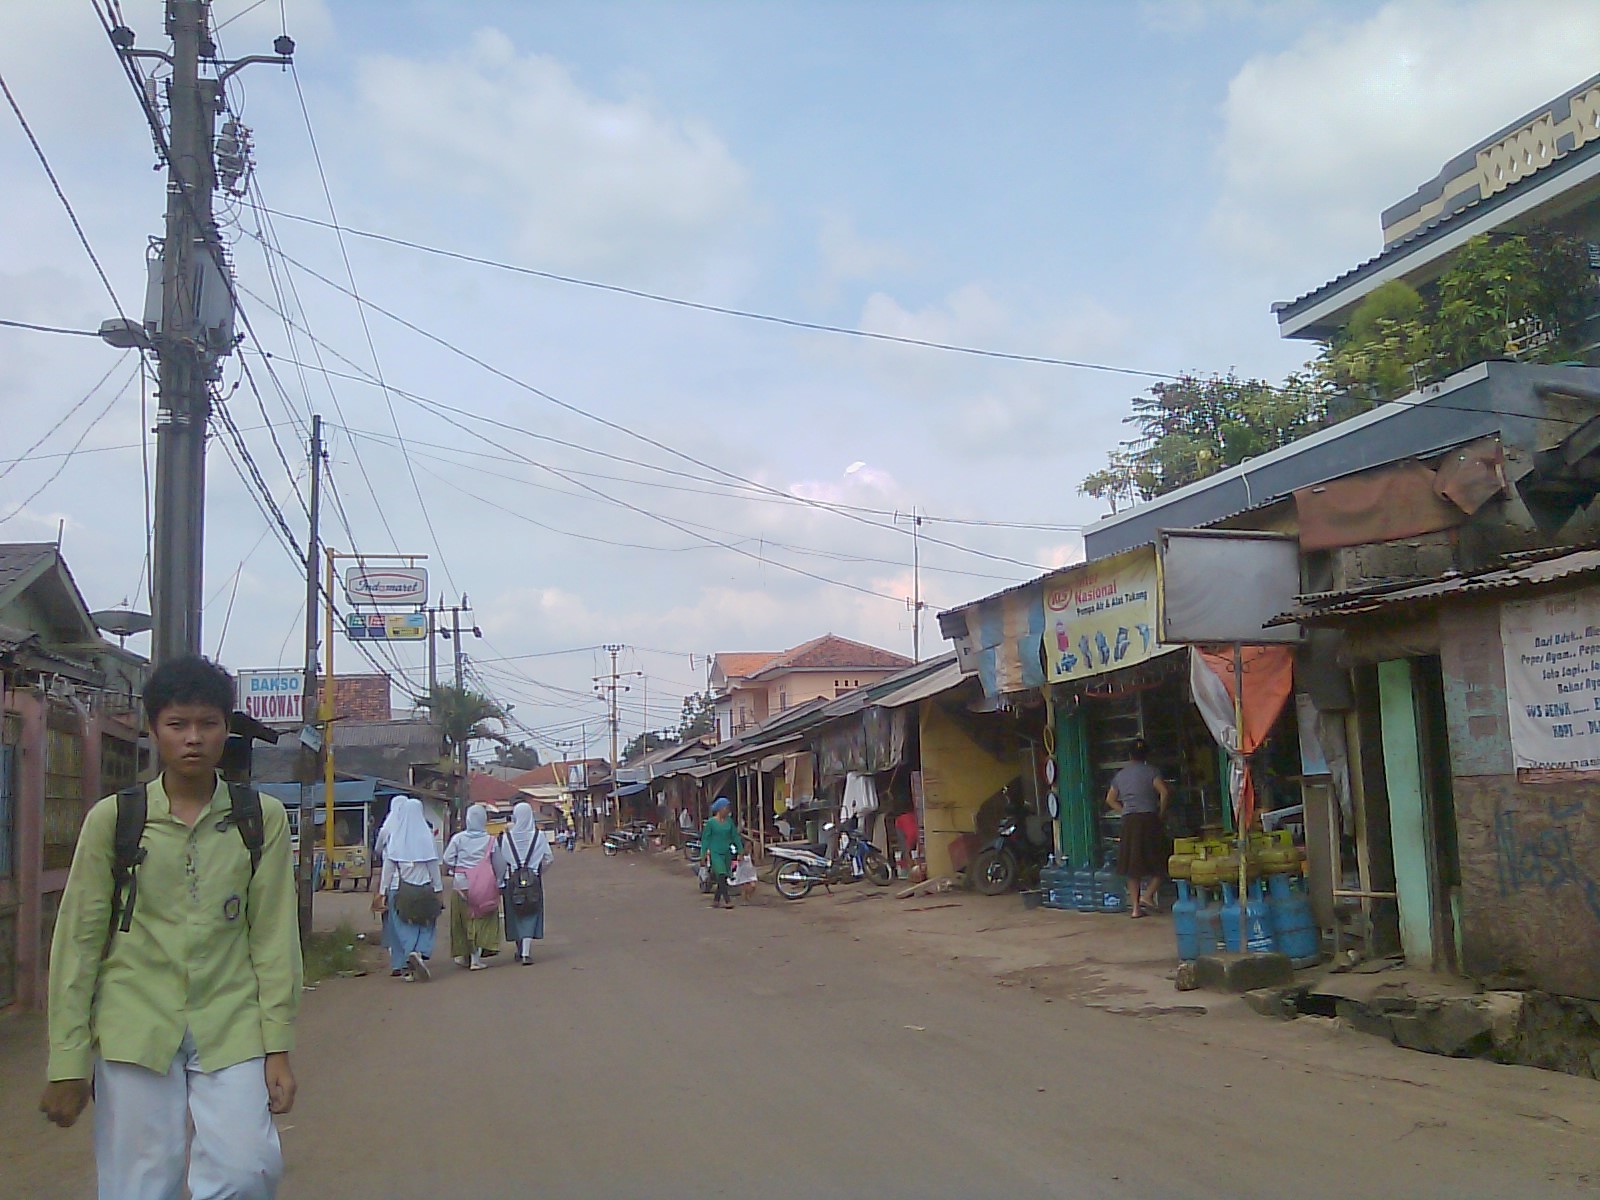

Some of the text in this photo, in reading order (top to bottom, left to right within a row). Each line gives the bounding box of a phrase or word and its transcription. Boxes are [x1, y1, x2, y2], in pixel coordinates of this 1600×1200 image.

[355, 580, 418, 592] Indomaret
[1075, 579, 1117, 605] Nasional
[251, 677, 299, 691] BAKSO
